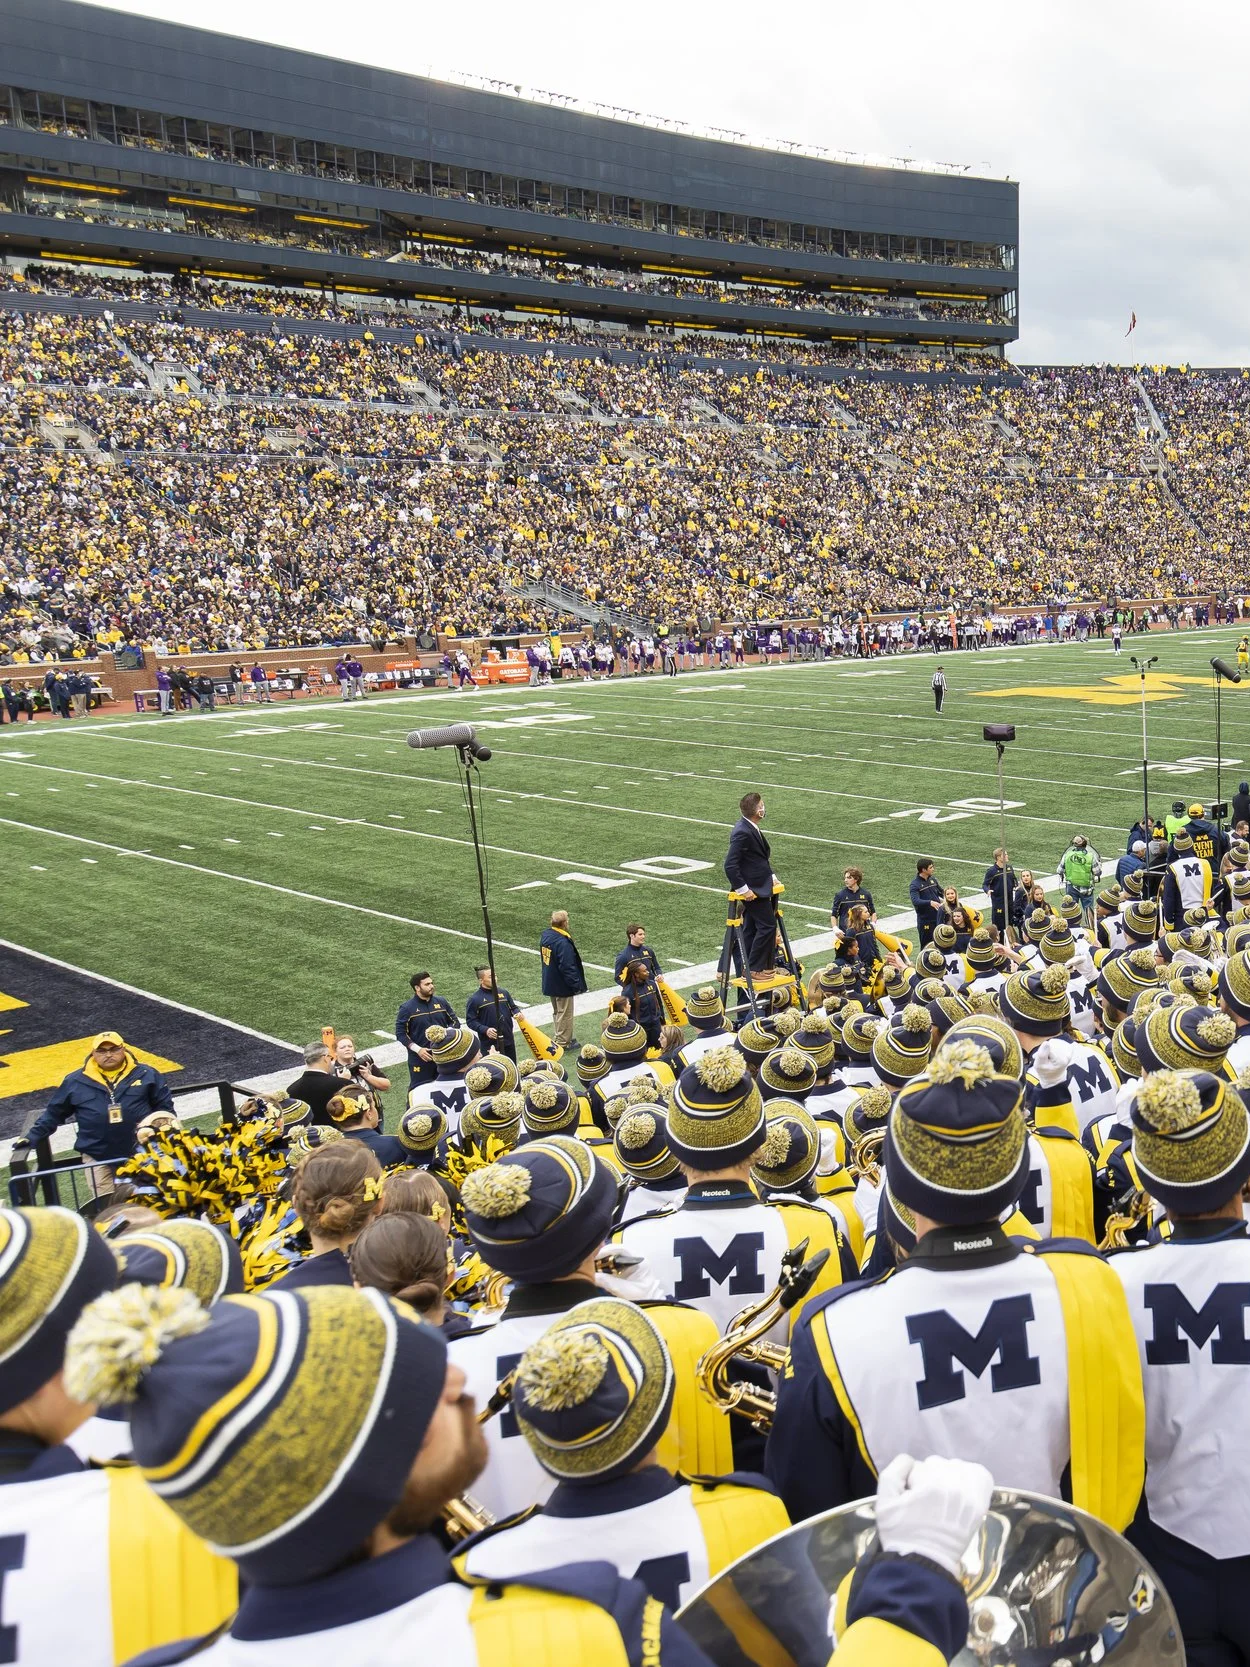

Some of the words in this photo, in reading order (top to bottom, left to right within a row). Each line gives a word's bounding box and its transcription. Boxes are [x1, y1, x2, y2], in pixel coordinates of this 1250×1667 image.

[1135, 756, 1244, 775] 30
[889, 797, 1028, 824] 20
[1193, 840, 1214, 851] EVENT
[1195, 849, 1214, 858] TEAM
[556, 855, 716, 890] 10
[1183, 863, 1202, 877] M
[660, 989, 680, 1022] MICHIGAN
[1069, 989, 1094, 1014] M
[1066, 1055, 1112, 1104] M
[364, 1176, 385, 1202] M
[701, 1188, 731, 1198] Neotech
[952, 1235, 994, 1252] Neotech
[673, 1231, 766, 1300] M
[906, 1293, 1042, 1410] M
